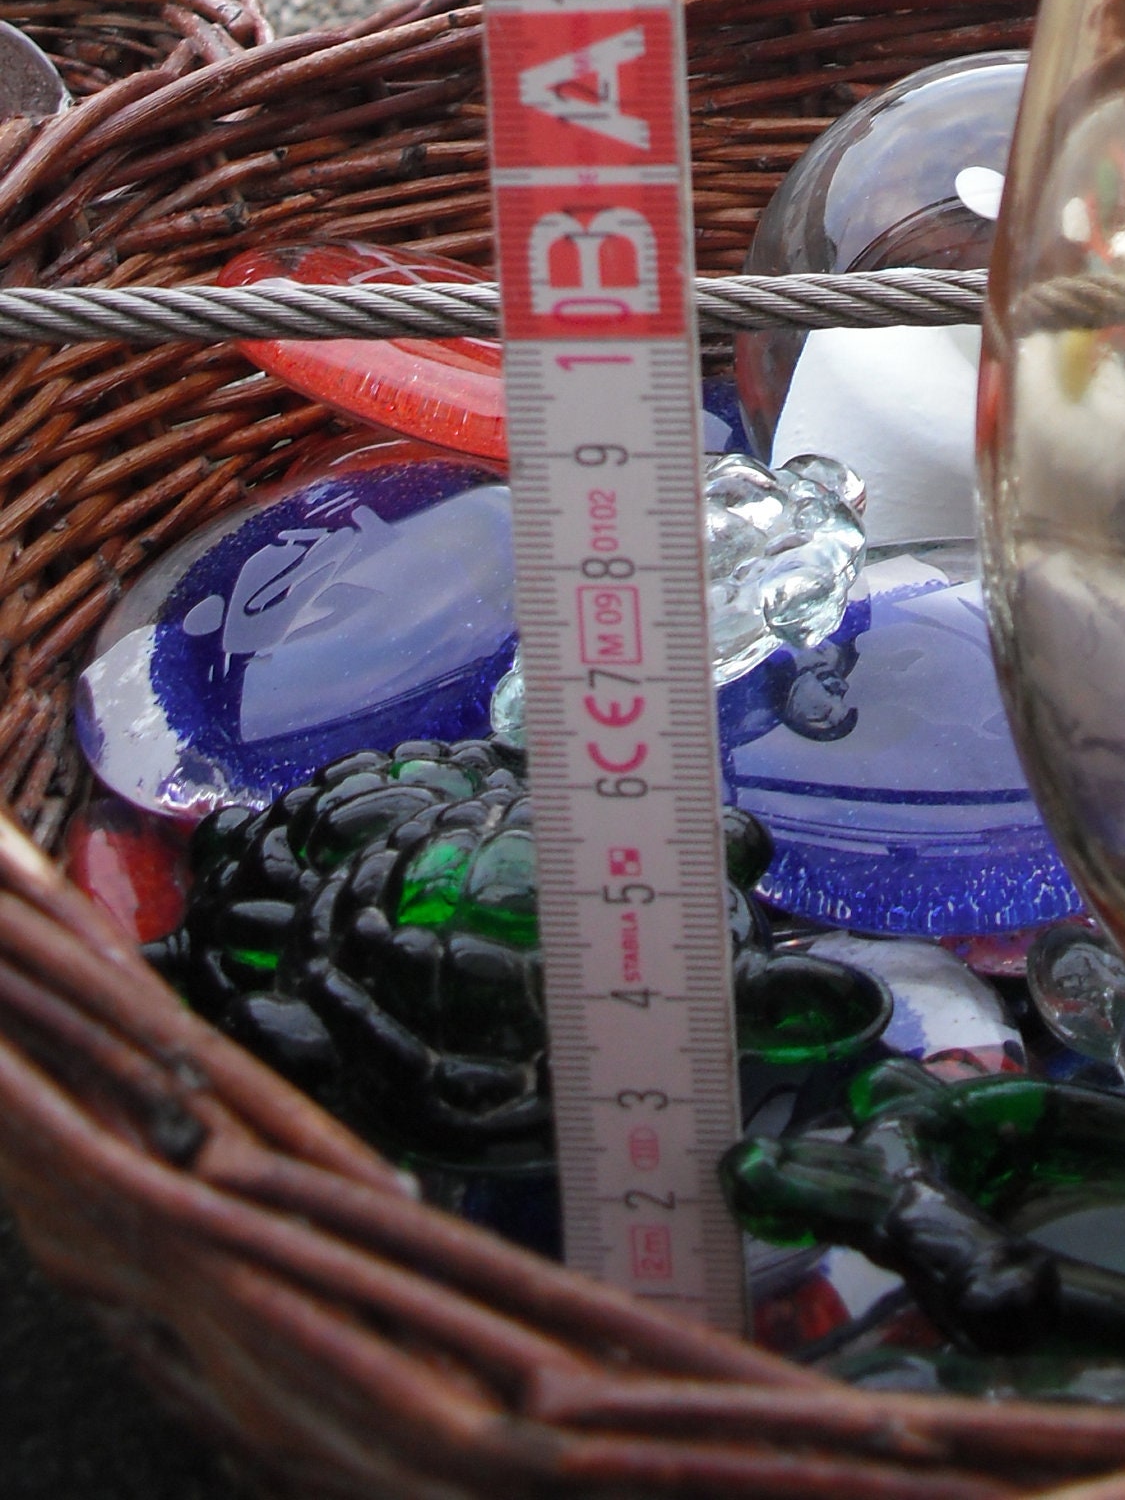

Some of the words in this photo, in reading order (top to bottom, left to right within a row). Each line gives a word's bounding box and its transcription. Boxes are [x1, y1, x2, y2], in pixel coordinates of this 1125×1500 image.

[556, 78, 612, 125] 12
[573, 442, 630, 467] 9
[587, 488, 619, 553] 0102
[581, 556, 636, 580] 8
[593, 593, 623, 625] 09
[597, 633, 625, 657] M
[588, 666, 644, 689] 7
[595, 776, 650, 800] 6
[602, 882, 657, 905] 5
[619, 911, 643, 984] STABILA
[609, 985, 661, 1010] 4
[617, 1088, 669, 1112] 3
[624, 1189, 677, 1211] 2
